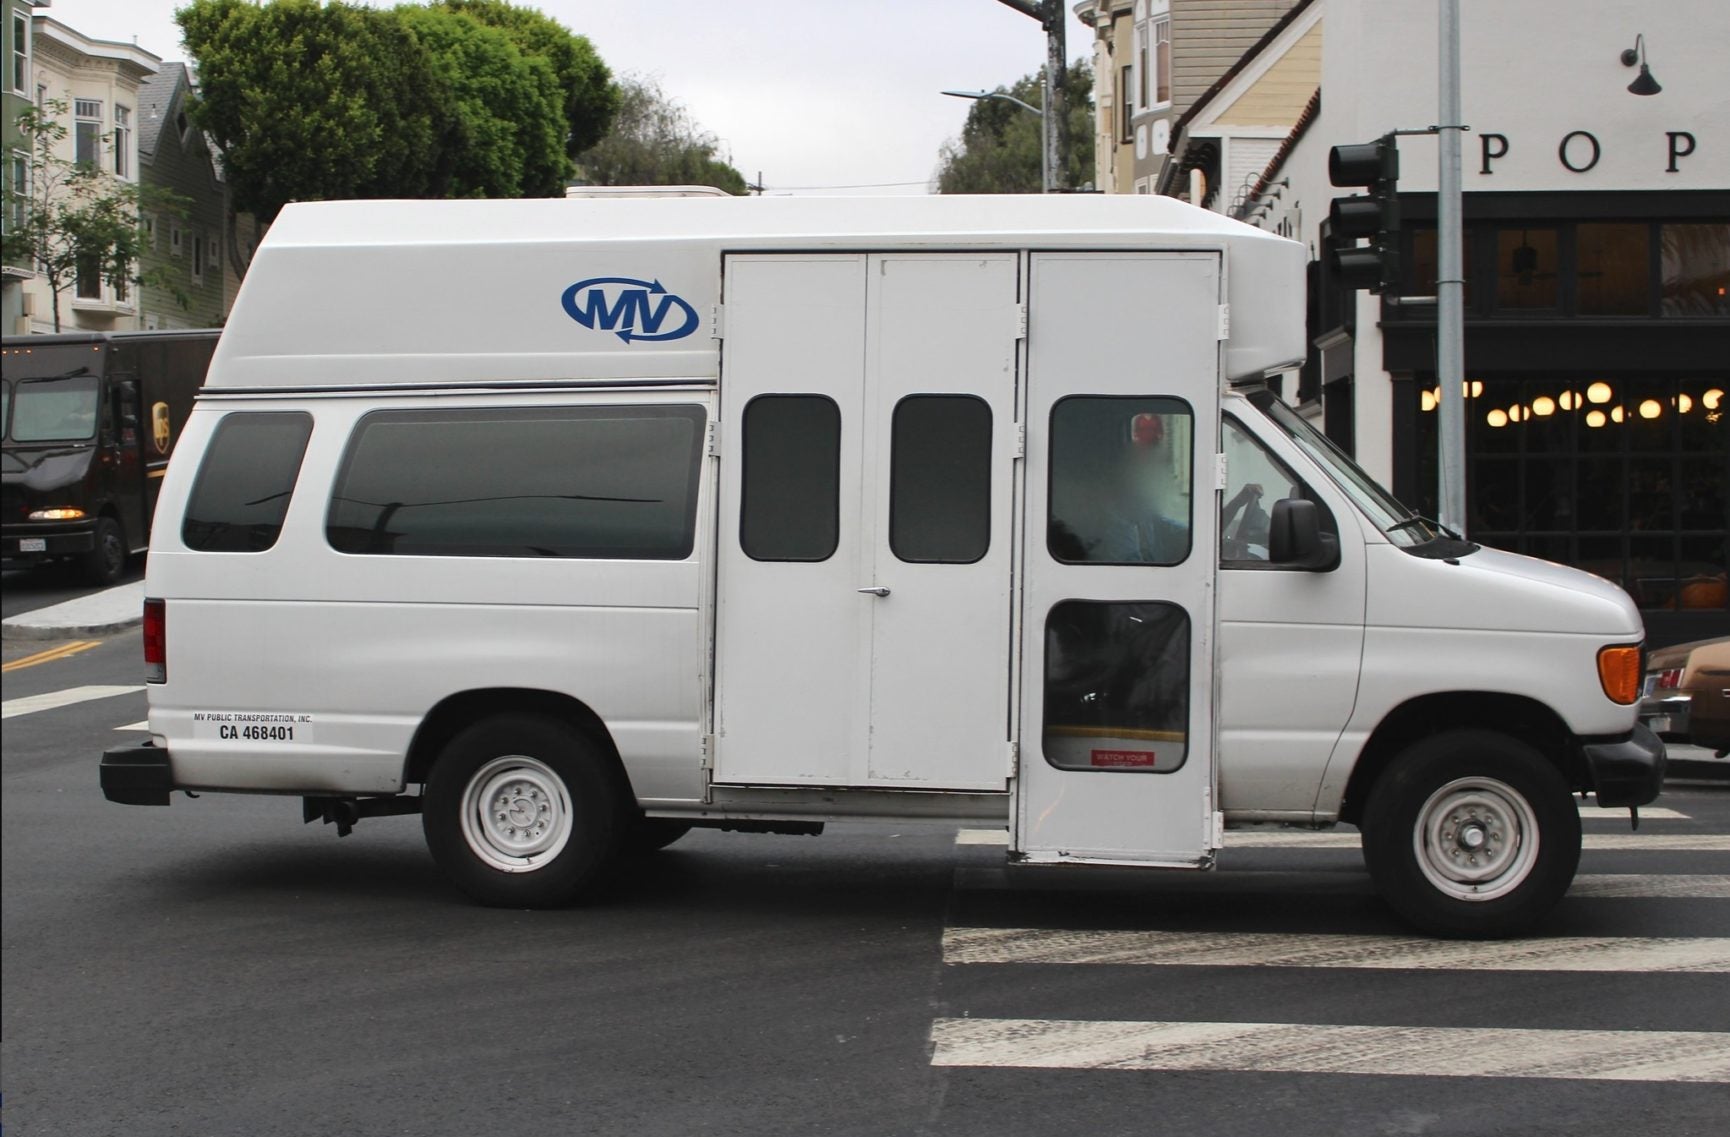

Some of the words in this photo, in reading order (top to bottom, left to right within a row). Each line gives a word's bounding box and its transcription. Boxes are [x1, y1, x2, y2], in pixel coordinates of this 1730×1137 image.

[1478, 130, 1697, 175] POP
[585, 289, 674, 334] MV
[194, 713, 206, 721] MV
[207, 713, 232, 722] PUBLIC
[235, 713, 296, 723] TRANSPORTATION,
[298, 714, 313, 723] INC.
[220, 725, 238, 740] CA
[243, 725, 293, 740] 468401
